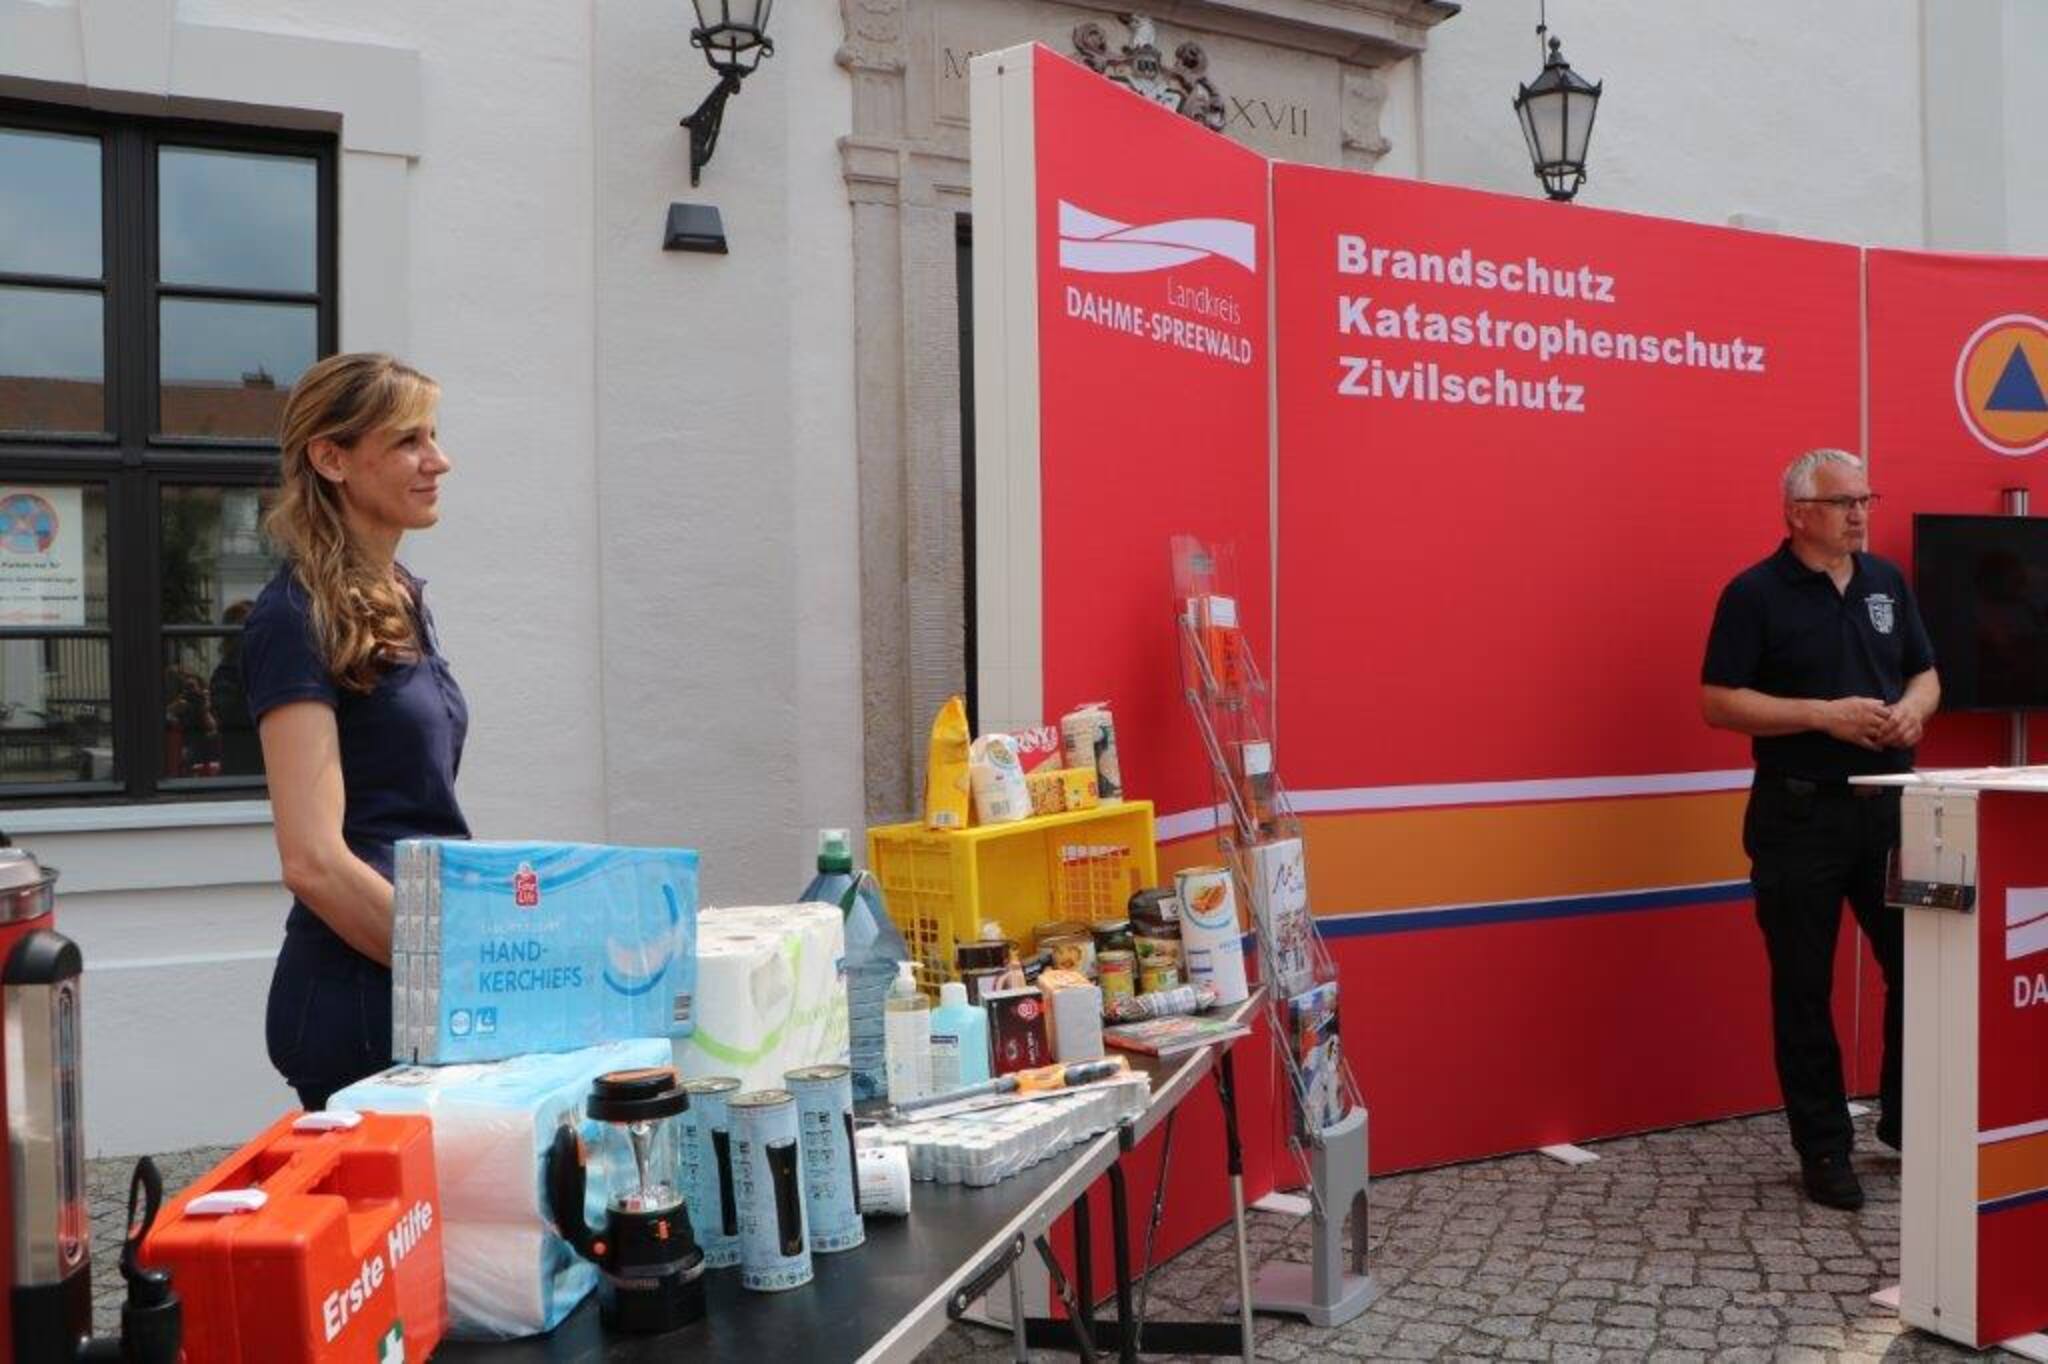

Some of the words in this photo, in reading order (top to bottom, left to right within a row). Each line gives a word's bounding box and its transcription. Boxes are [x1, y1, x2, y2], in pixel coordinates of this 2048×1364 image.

[1229, 95, 1309, 137] XVII
[1337, 234, 1616, 303] Brandschutz
[1066, 285, 1252, 366] DAHME-SPREEWALD
[1167, 275, 1241, 325] Landkreis
[1338, 295, 1766, 373] Katastrophenschutz
[1337, 356, 1586, 413] Zivilschutz
[478, 966, 584, 993] KERCHIEFS
[479, 940, 550, 965] HAND-
[321, 1254, 385, 1344] Erste
[387, 1200, 434, 1270] Hilfe
